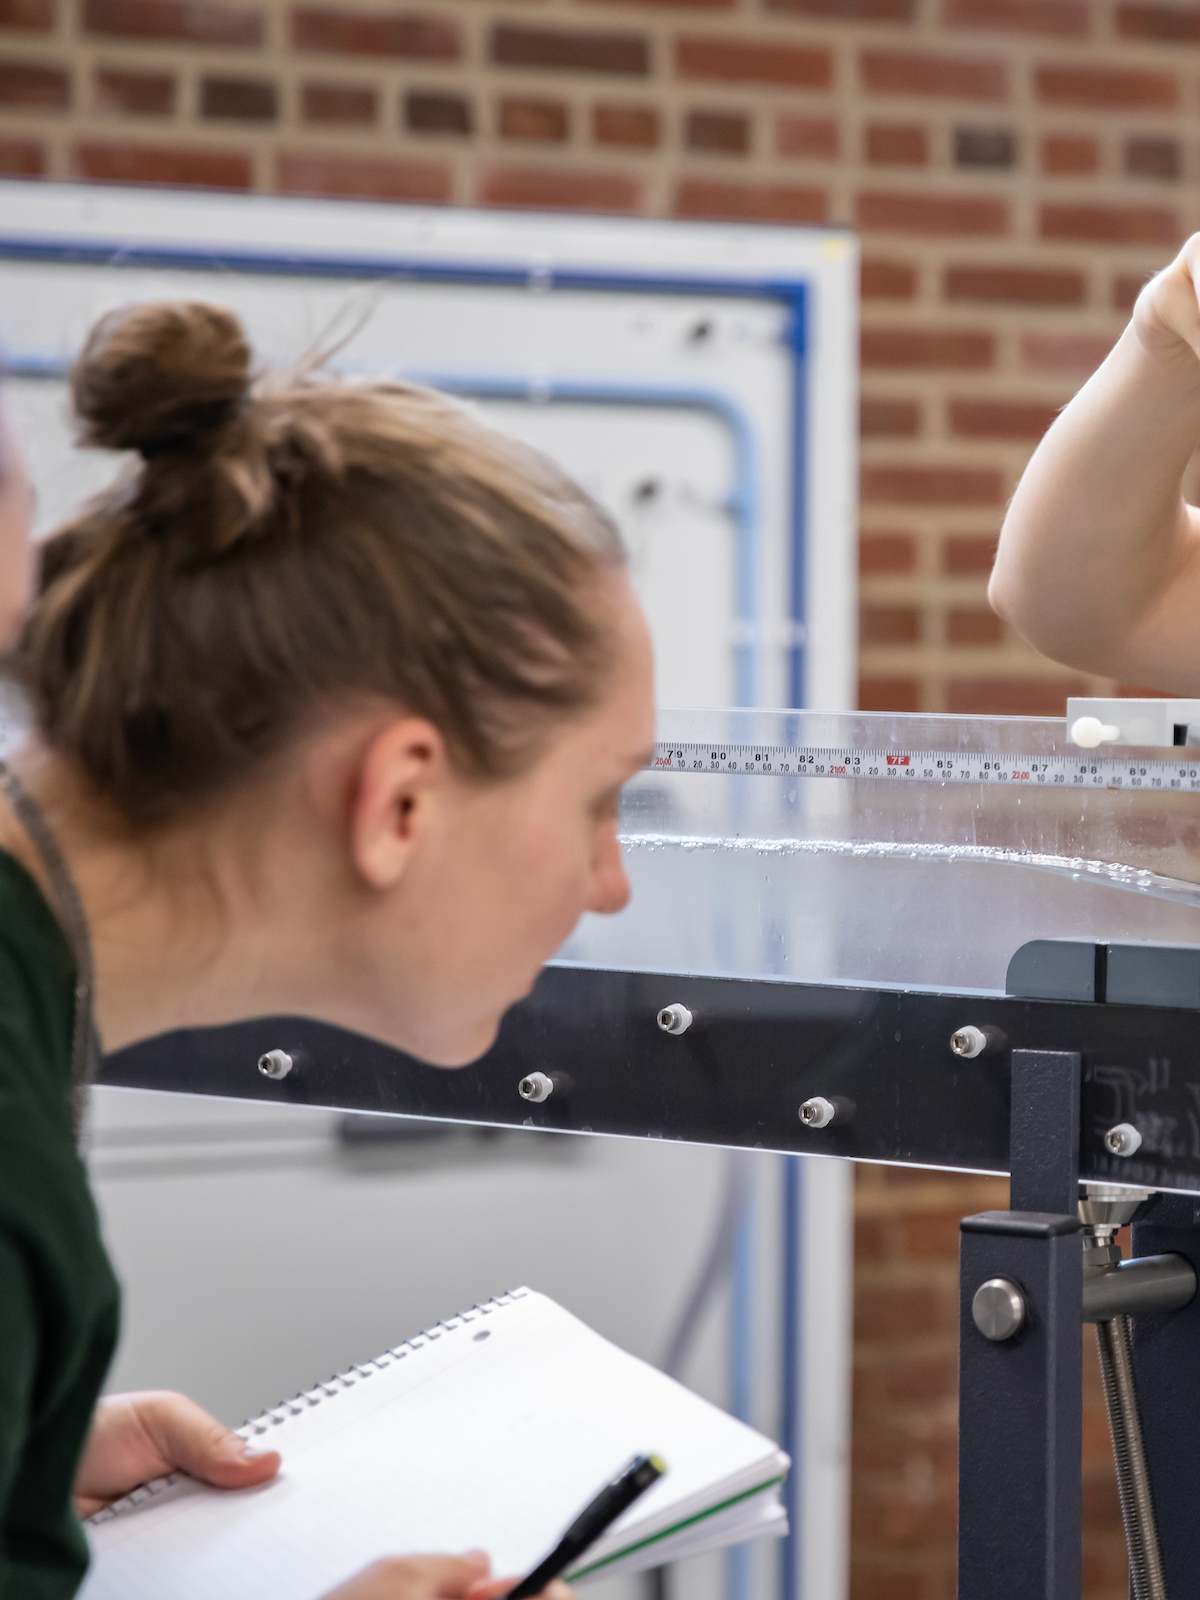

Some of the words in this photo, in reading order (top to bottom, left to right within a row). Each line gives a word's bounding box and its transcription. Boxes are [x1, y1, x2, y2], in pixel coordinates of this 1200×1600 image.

[668, 750, 683, 758] 79
[711, 752, 726, 760] 80
[755, 753, 769, 761] 81
[799, 755, 814, 763] 82
[845, 757, 860, 765] 83
[890, 757, 905, 765] 7F
[937, 760, 953, 768] 85
[984, 762, 1000, 770] 86
[1032, 764, 1048, 772] 87
[1081, 766, 1097, 774] 88
[1130, 768, 1146, 776] 89
[678, 760, 685, 768] 10
[710, 761, 719, 769] 30
[728, 762, 736, 770] 40
[745, 762, 754, 770] 50
[763, 763, 772, 771] 60
[798, 764, 807, 772] 80
[816, 765, 824, 773] 90
[830, 766, 846, 774] 2100
[869, 767, 878, 775] 20
[887, 768, 896, 776] 30
[905, 769, 914, 777] 40
[924, 770, 933, 778] 50
[942, 770, 951, 778] 60
[961, 771, 970, 779] 70
[979, 771, 988, 779] 80
[998, 772, 1007, 780] 90
[1012, 771, 1029, 780] 2200
[1037, 774, 1045, 782] 10
[1055, 774, 1064, 782] 20
[1093, 776, 1103, 784] 40
[1113, 777, 1122, 785] 50
[1132, 778, 1142, 786] 60
